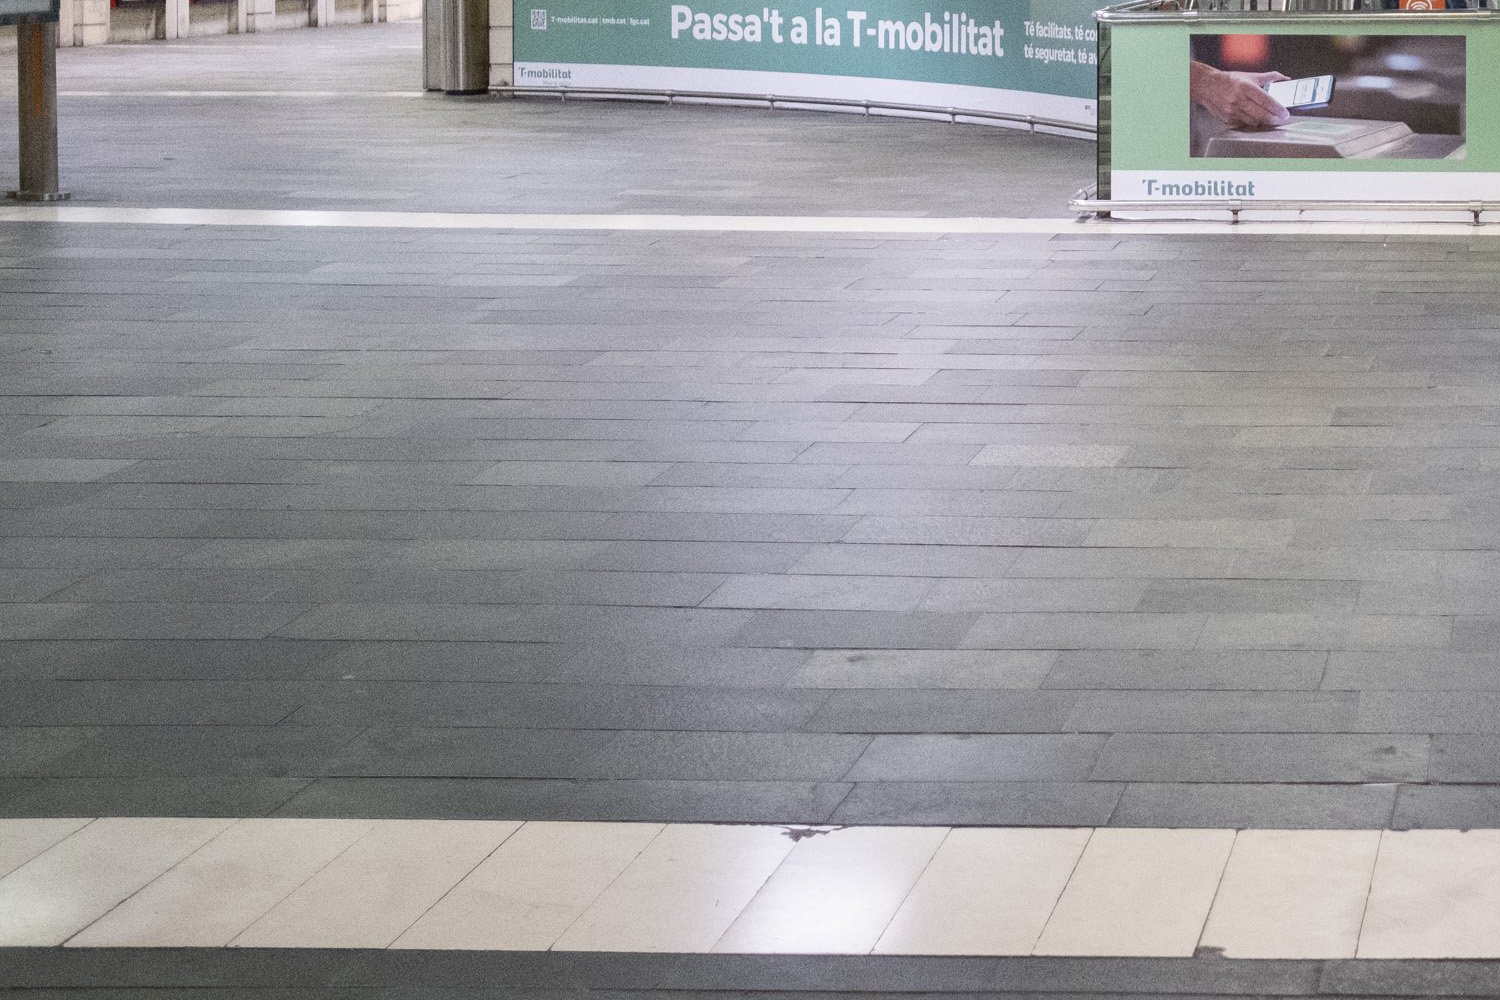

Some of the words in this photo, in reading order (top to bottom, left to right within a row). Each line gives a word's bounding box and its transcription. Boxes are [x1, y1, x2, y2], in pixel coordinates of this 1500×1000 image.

[670, 4, 784, 44] Passa't
[790, 19, 808, 45] a
[815, 7, 841, 47] la
[847, 10, 1005, 58] T-mobilitat
[1024, 20, 1035, 36] Té
[1036, 21, 1073, 41] facilitats,
[1075, 25, 1084, 40] té
[1024, 43, 1034, 58] té
[1035, 47, 1077, 64] seguretat,
[1078, 48, 1087, 64] té
[517, 66, 572, 80] T-mobilitat
[1142, 178, 1255, 198] T-mobilitat
